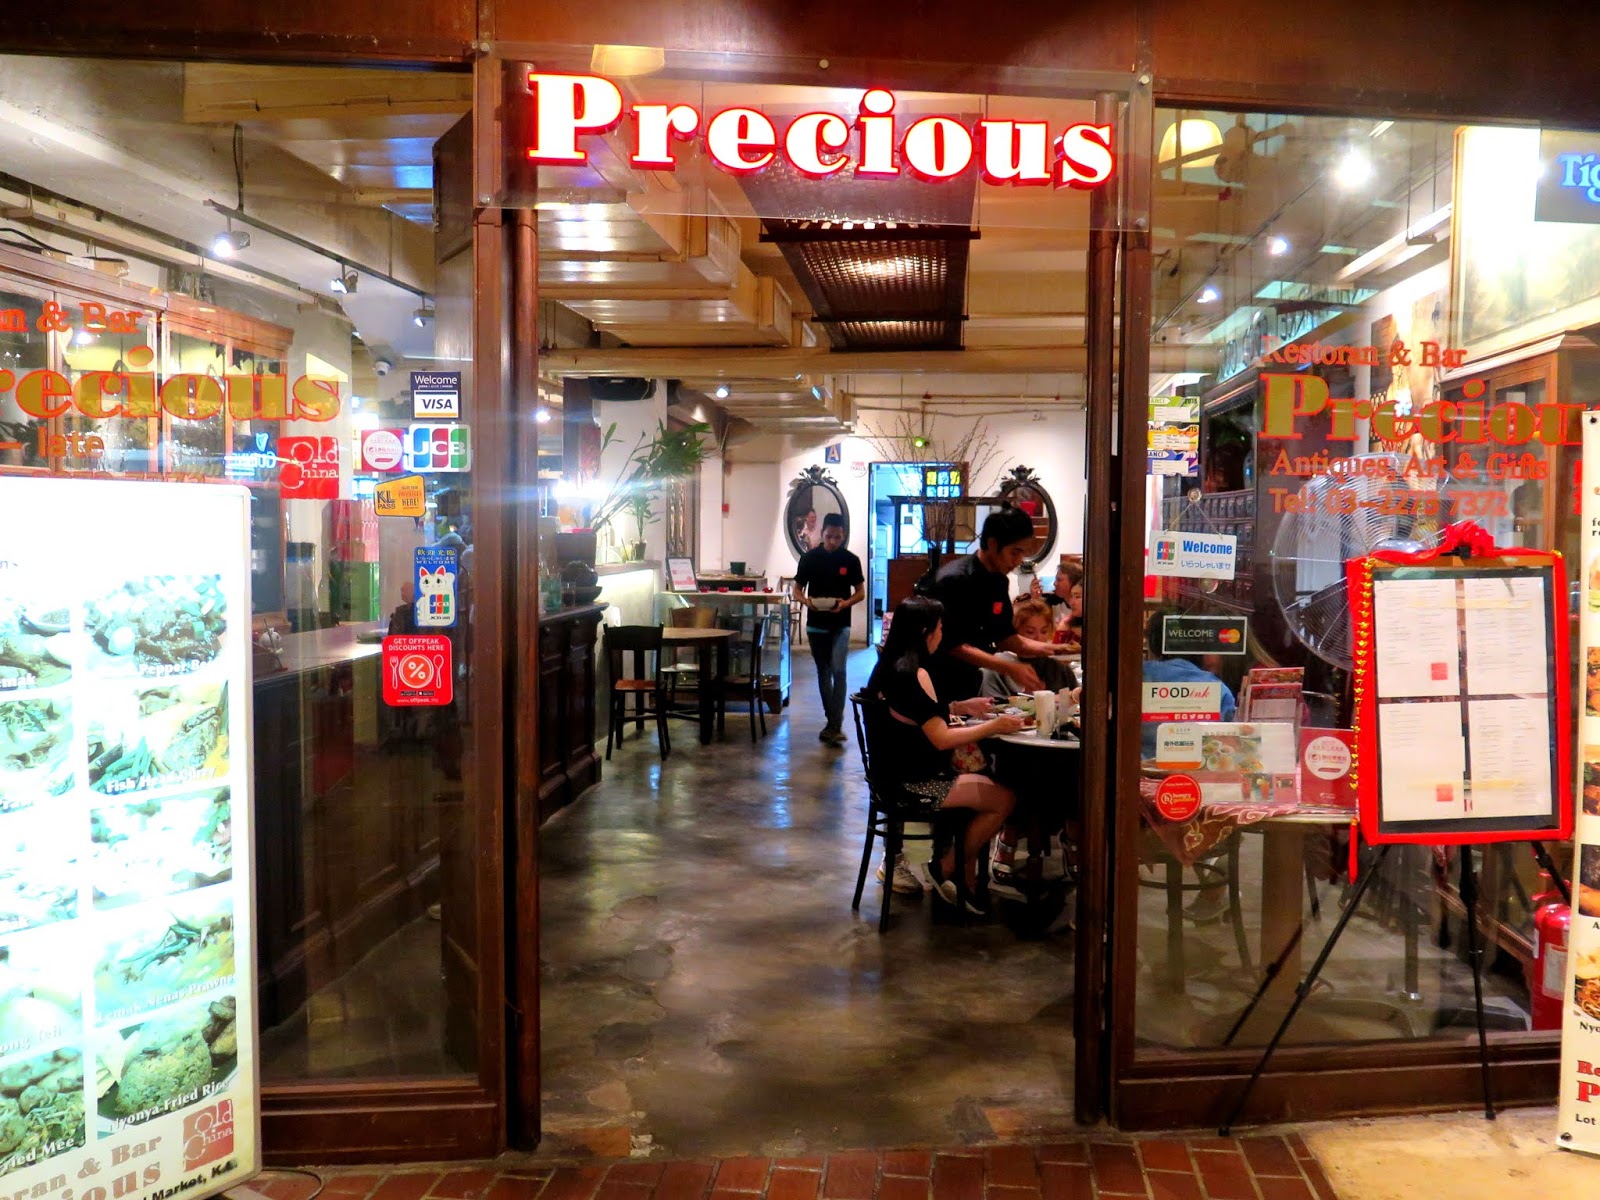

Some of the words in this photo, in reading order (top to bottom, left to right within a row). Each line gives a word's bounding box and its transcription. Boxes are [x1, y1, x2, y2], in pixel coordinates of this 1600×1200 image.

[526, 71, 1116, 190] Precious
[36, 301, 72, 333] &
[79, 302, 144, 334] Bar
[1260, 335, 1380, 367] Restoran
[1386, 340, 1412, 367] &
[1418, 341, 1468, 368] Bar
[0, 345, 341, 422] ecious
[414, 374, 458, 385] Welcome
[421, 398, 453, 410] VISA
[1257, 372, 1584, 447] Preciou
[37, 426, 105, 459] late
[290, 436, 339, 464] Old
[279, 461, 340, 490] China
[1269, 448, 1397, 484] Antiques,
[1402, 450, 1448, 479] Art
[1453, 451, 1479, 480] &
[1486, 452, 1549, 480] Gifts
[376, 490, 396, 504] KL
[1268, 485, 1316, 514] Tel:
[1447, 490, 1510, 517] 7372
[1182, 540, 1233, 555] Welcome
[1180, 560, 1232, 569] いらっしゃいませ
[1168, 629, 1214, 638] WELCOME
[0, 672, 37, 688] mak
[106, 776, 136, 794] Fish
[163, 1088, 198, 1113] Fried
[202, 1078, 232, 1098] Rice
[193, 1100, 233, 1134] Old
[1575, 1113, 1596, 1126] Lot
[42, 1136, 75, 1157] Mee
[184, 1127, 233, 1161] China
[0, 1172, 67, 1200] ran
[77, 1157, 101, 1179] &
[111, 1135, 162, 1167] Bar
[152, 1173, 207, 1200] Market,
